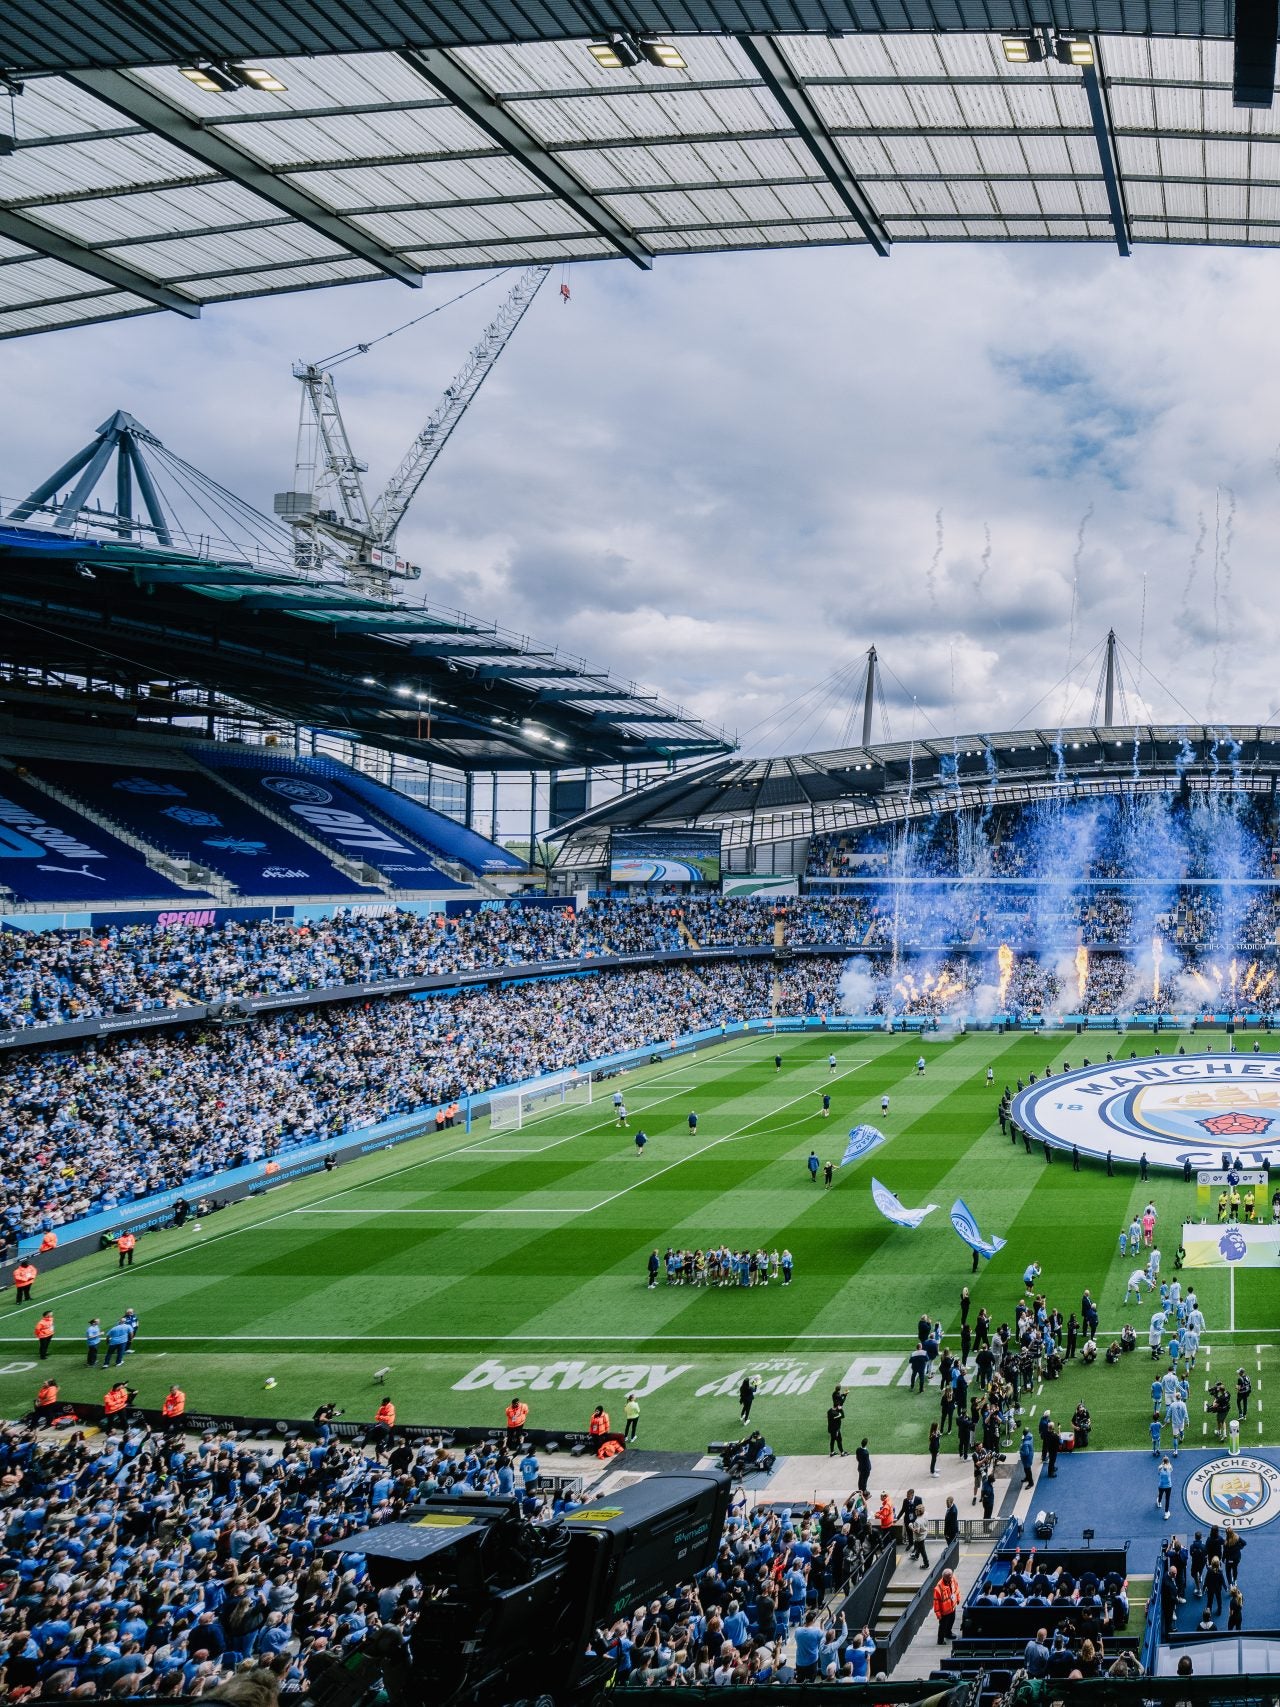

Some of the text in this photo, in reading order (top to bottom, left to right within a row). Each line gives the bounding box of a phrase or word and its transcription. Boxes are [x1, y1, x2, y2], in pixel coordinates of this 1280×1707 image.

[16, 825, 109, 858] SOON
[290, 804, 416, 855] CITY
[100, 1020, 132, 1029] Welcome
[1054, 1102, 1084, 1111] 18
[451, 1359, 695, 1399] betway
[1195, 1460, 1278, 1484] MANCHESTER
[1222, 1518, 1255, 1526] CITY
